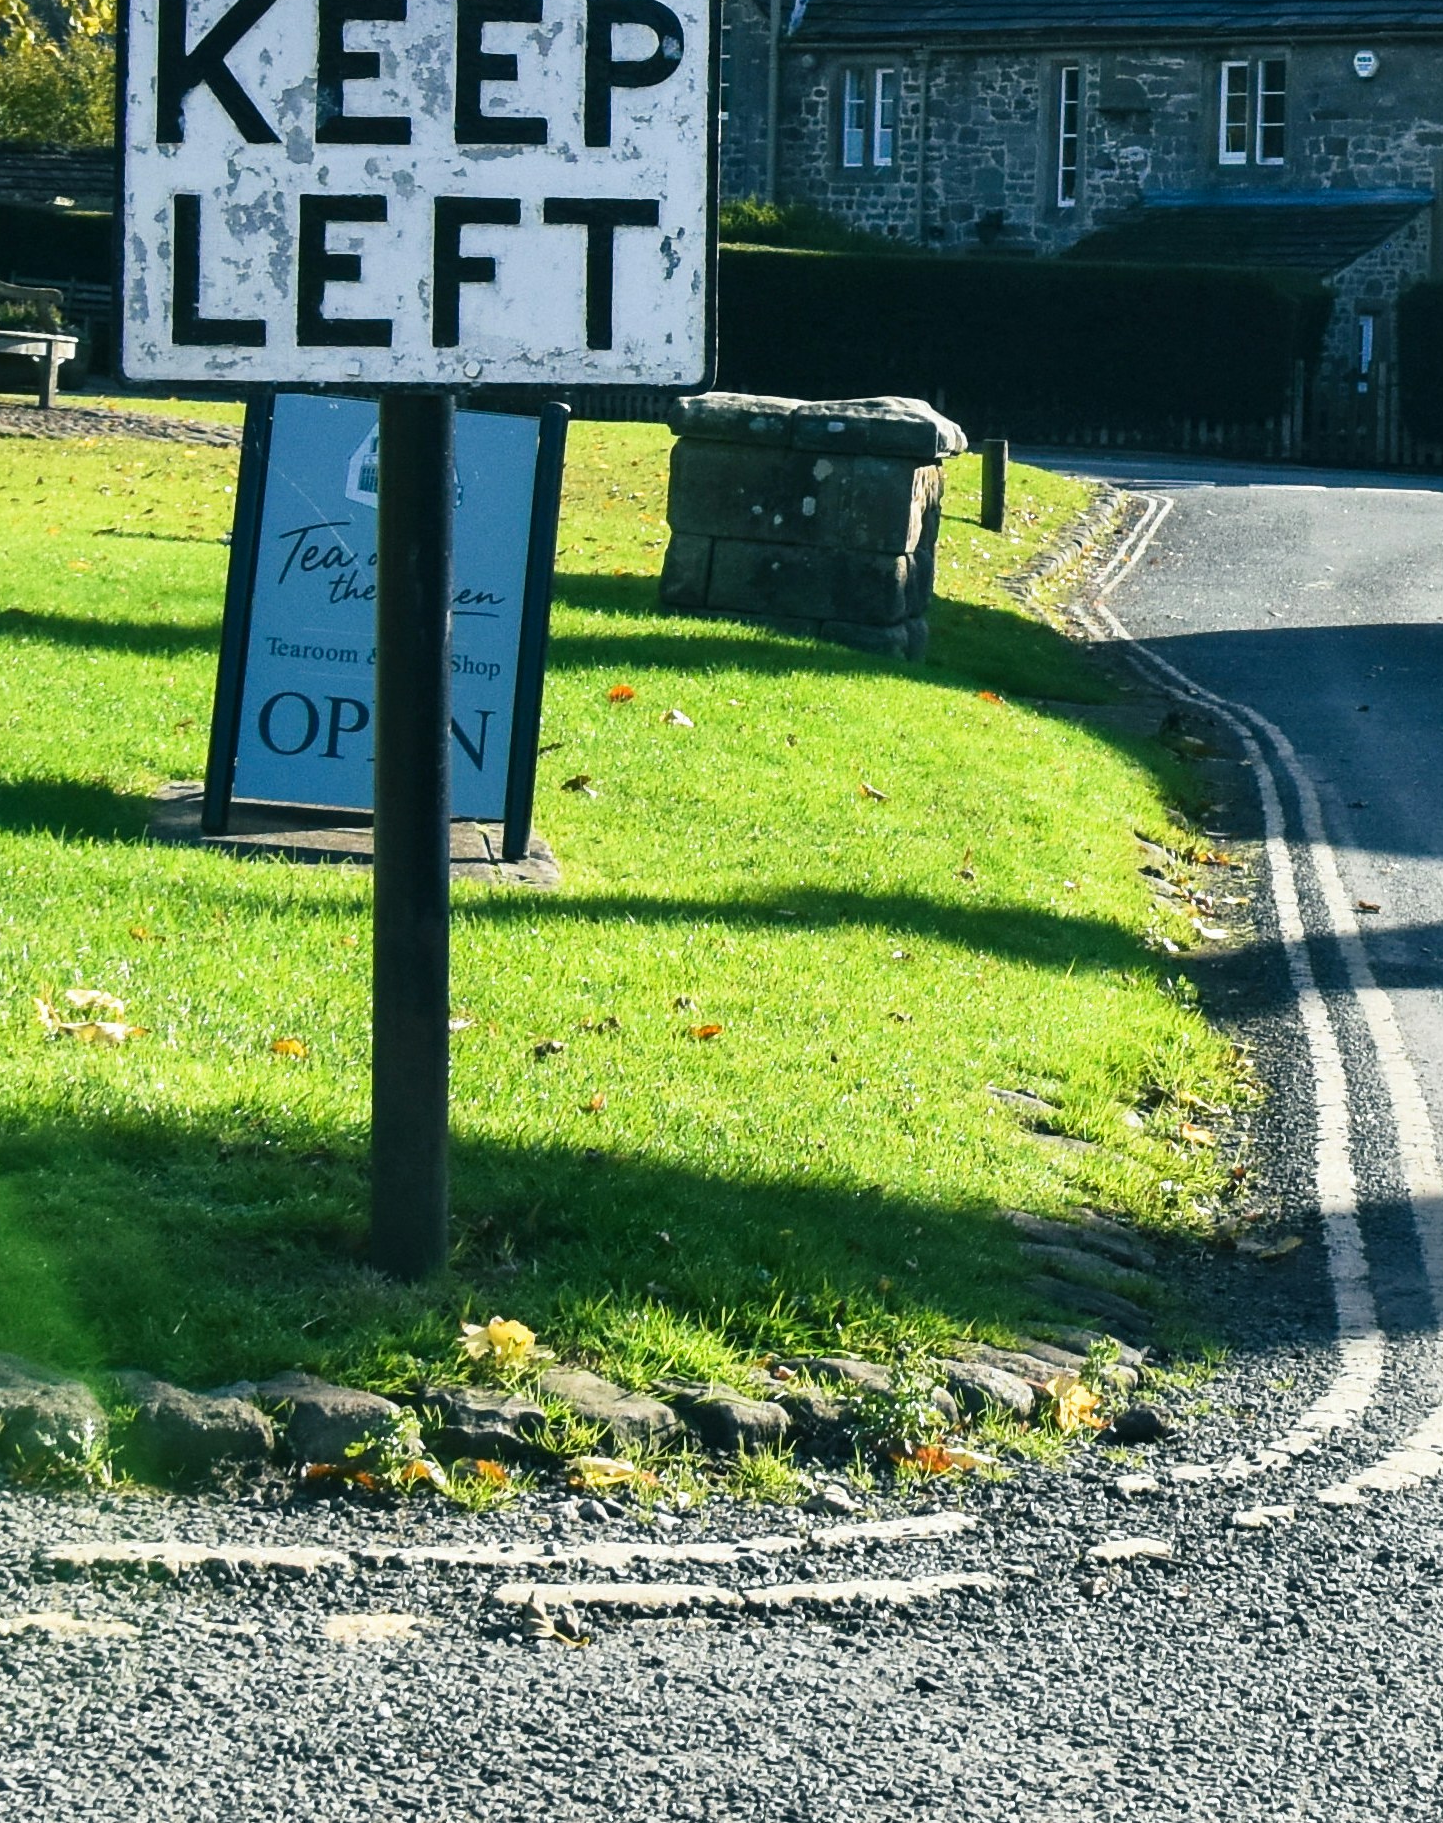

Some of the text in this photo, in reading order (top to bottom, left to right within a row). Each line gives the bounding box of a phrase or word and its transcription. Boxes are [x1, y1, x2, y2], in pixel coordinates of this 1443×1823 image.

[171, 193, 660, 350] LEFT
[278, 521, 358, 584] Tea
[329, 571, 377, 604] the
[266, 637, 358, 664] Tearoom
[451, 654, 502, 681] Shop
[258, 691, 497, 772] OPN
